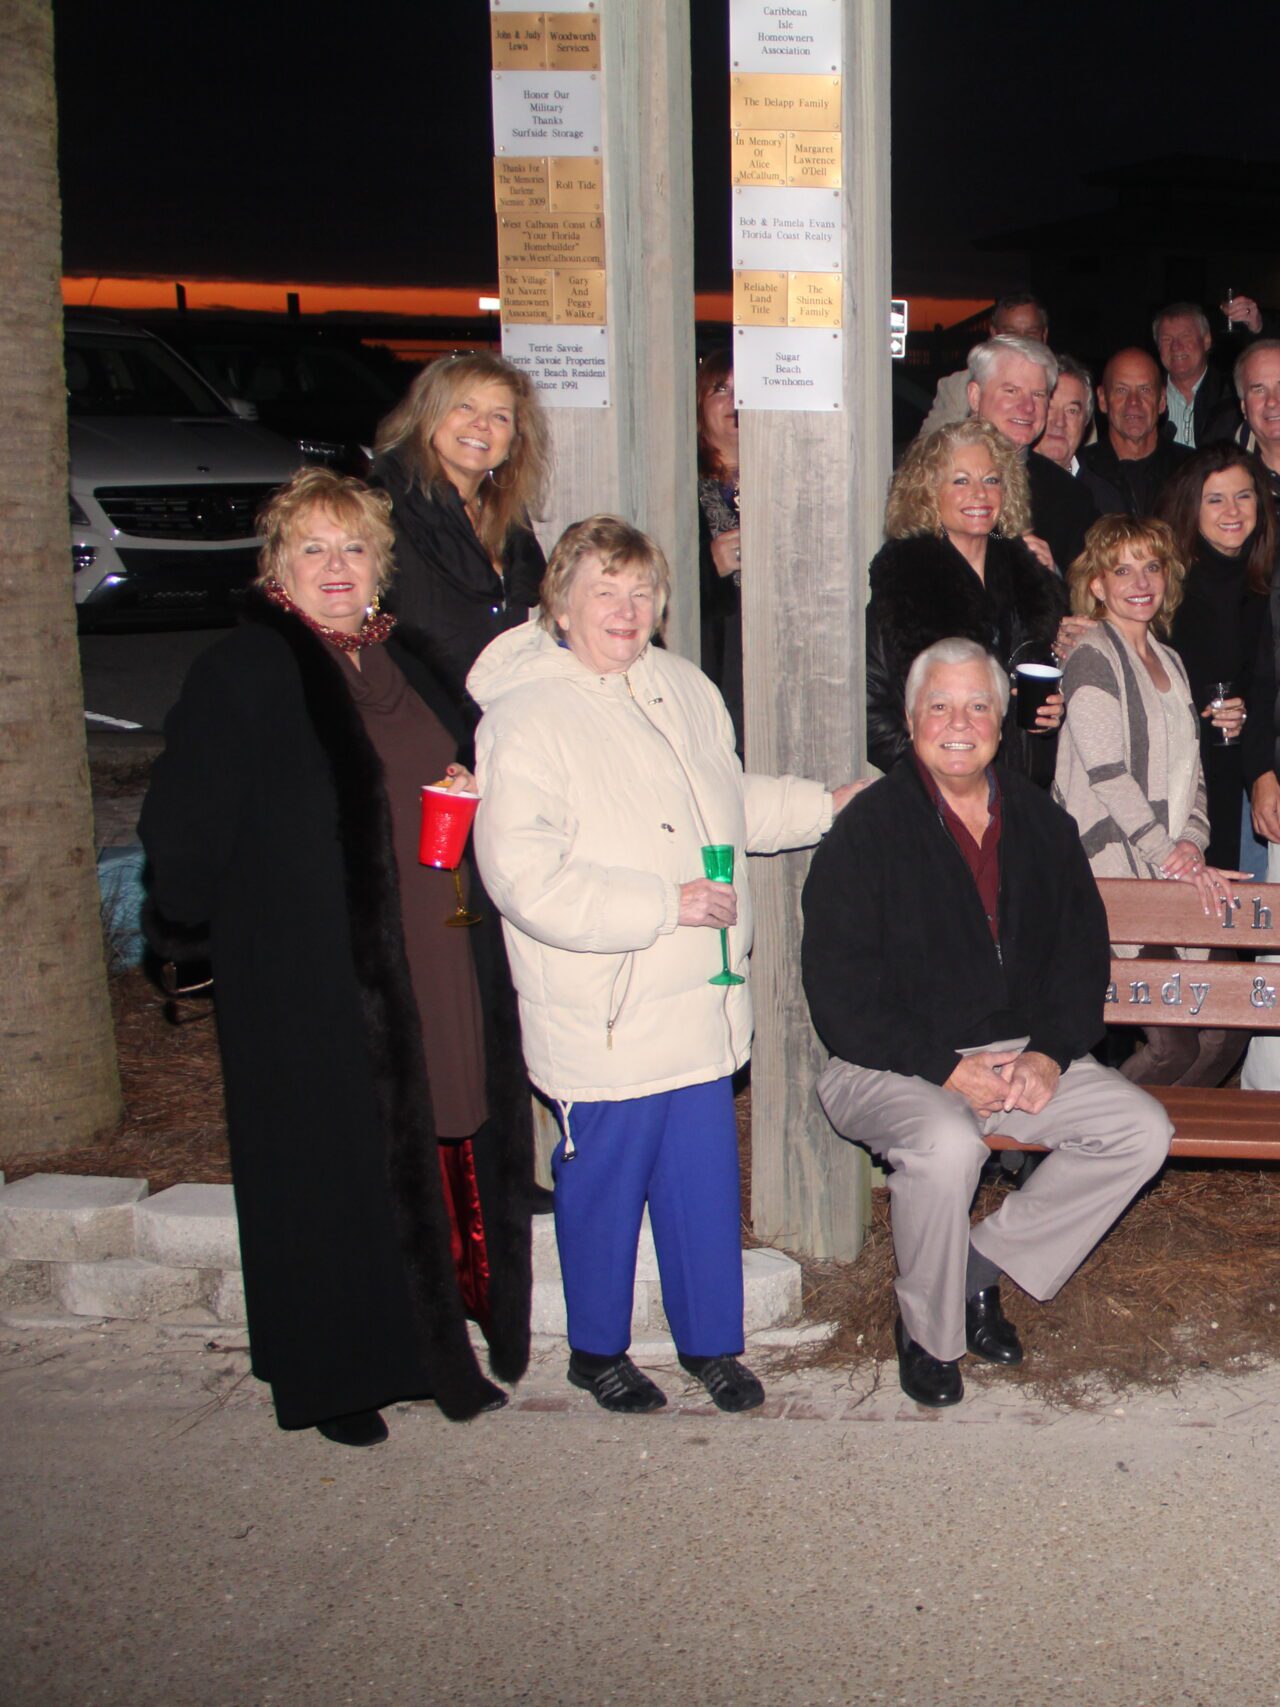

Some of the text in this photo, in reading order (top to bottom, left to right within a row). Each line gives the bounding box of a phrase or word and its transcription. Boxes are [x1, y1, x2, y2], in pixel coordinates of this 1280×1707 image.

[763, 7, 808, 16] Caribbean
[778, 20, 793, 29] Isle
[495, 30, 511, 39] John
[525, 30, 542, 40] Judy
[550, 32, 596, 41] Woodworth
[758, 32, 814, 42] Homeowners
[557, 43, 590, 52] Services
[761, 46, 811, 55] Association
[523, 90, 570, 99] Honor Our
[530, 103, 564, 113] Military
[744, 97, 759, 106] The
[800, 98, 830, 109] Family
[532, 115, 564, 125] Thanks
[512, 128, 584, 139] Surfside Storage
[736, 137, 782, 148] In Memory
[753, 149, 764, 157] Of
[795, 144, 833, 154] Margaret
[749, 160, 770, 169] Alice
[793, 155, 836, 165] Lawrence
[739, 170, 780, 180] McCallum
[801, 167, 827, 176] O'Dell
[556, 180, 597, 190] Roll Tide
[525, 220, 559, 229] Calhoun
[739, 216, 757, 226] Bob
[773, 218, 805, 228] Pamela
[809, 219, 836, 229] Evans
[552, 231, 581, 240] Florida
[742, 230, 833, 242] Florida Coast Realty
[505, 275, 547, 285] The Village
[569, 276, 589, 287] Gary
[506, 287, 547, 296] At Navarre
[571, 288, 589, 296] And
[744, 282, 778, 292] Reliable
[808, 284, 824, 294] The
[504, 297, 550, 306] Homeowners
[750, 293, 772, 303] Land
[567, 298, 593, 309] Peggy
[508, 309, 548, 318] Association
[565, 309, 596, 319] Walker
[750, 305, 771, 314] Title
[799, 306, 831, 318] Family
[528, 343, 584, 353] Terrie Savoie
[535, 356, 561, 365] Savoie
[566, 356, 606, 366] Properties
[775, 352, 800, 363] Sugar
[544, 368, 568, 377] Beach
[572, 368, 607, 378] Resident
[775, 364, 802, 374] Beach
[535, 381, 578, 390] Since 1991
[763, 376, 815, 386] Townhomes
[1105, 973, 1211, 1015] andy
[1250, 976, 1278, 1009] &
